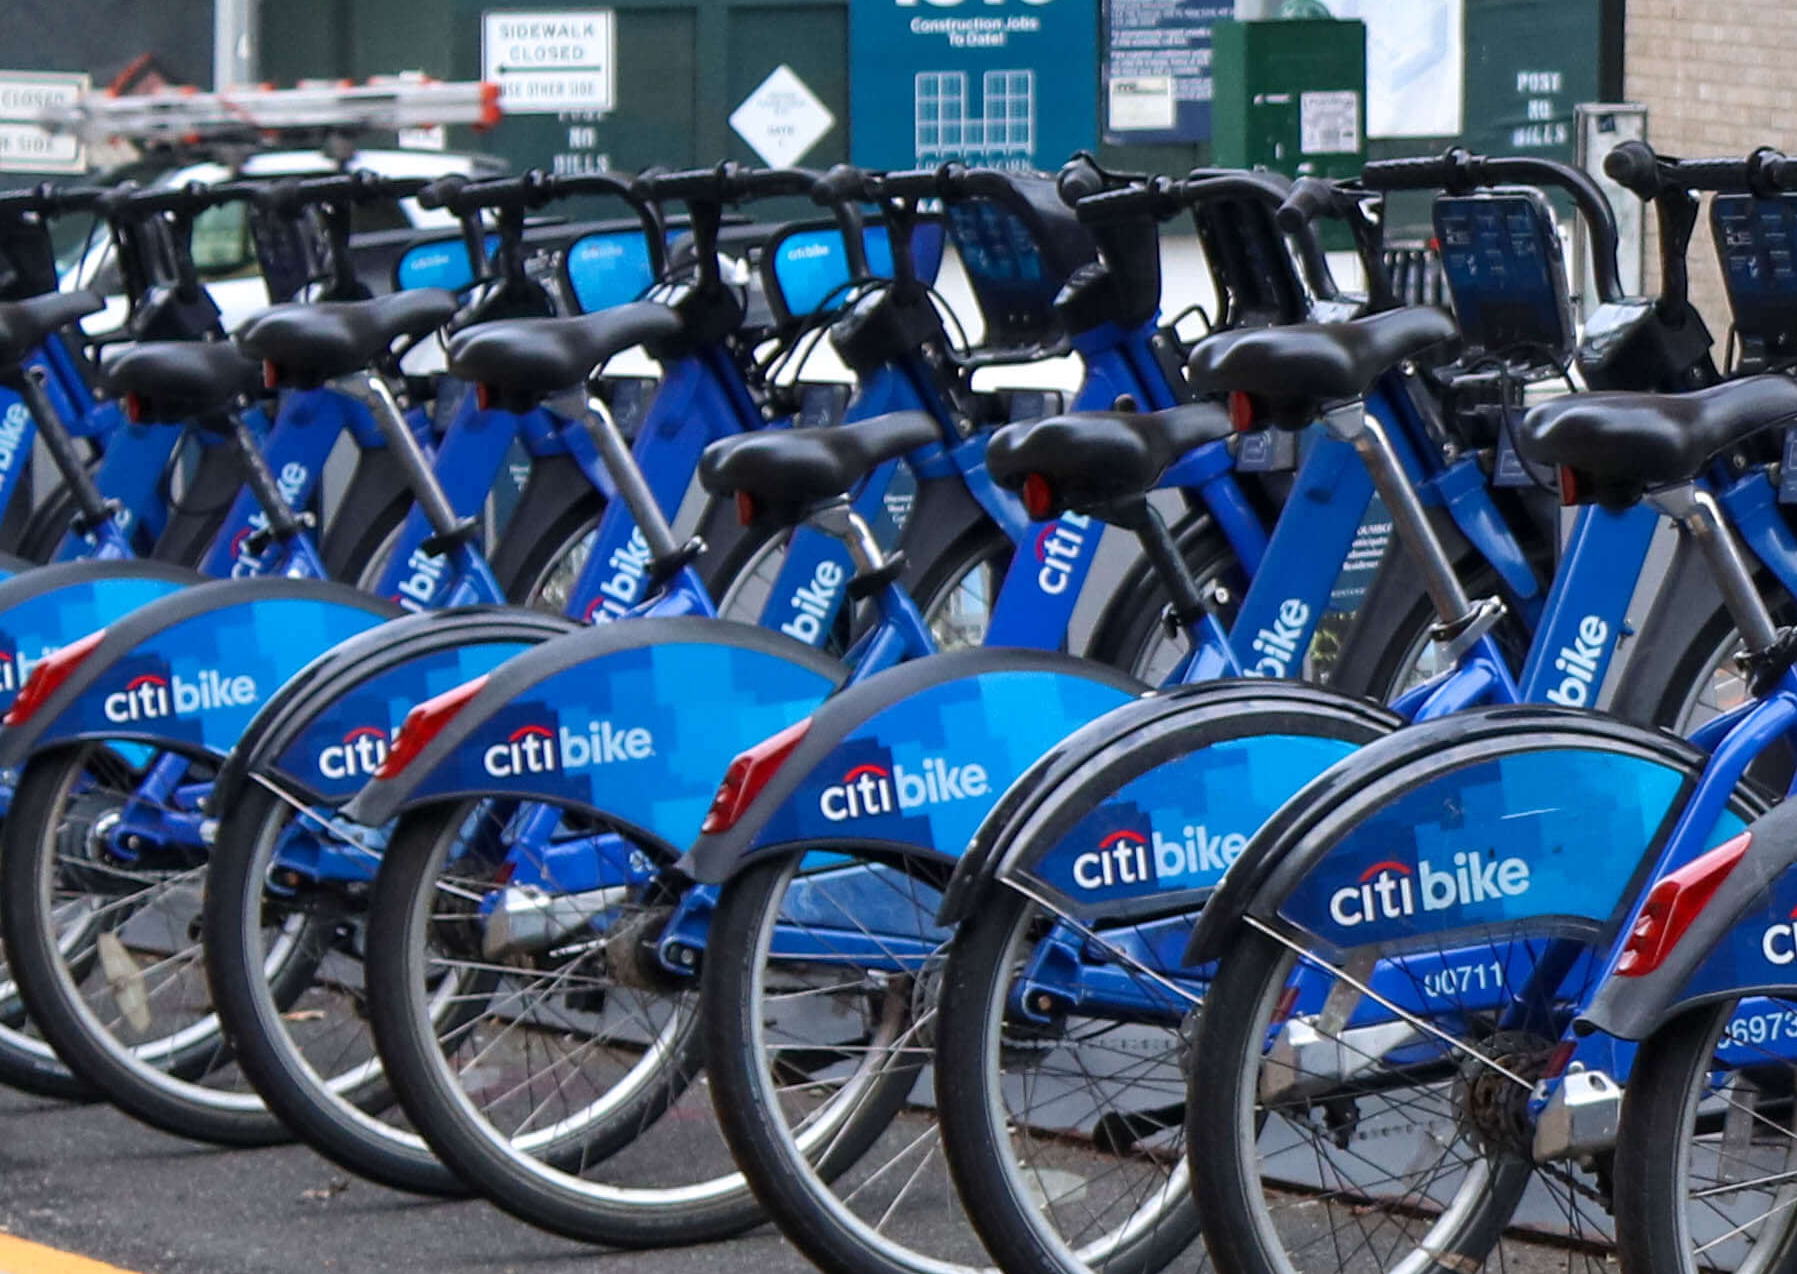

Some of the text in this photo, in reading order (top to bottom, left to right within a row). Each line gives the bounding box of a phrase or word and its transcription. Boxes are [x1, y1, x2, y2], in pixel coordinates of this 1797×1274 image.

[500, 23, 595, 38] SIDEWALK
[910, 15, 1040, 33] Construction Jobs
[948, 32, 965, 46] To
[510, 45, 585, 61] CLOSED
[527, 82, 564, 97] OTHER
[1517, 72, 1561, 93] POST
[1528, 99, 1551, 121] NO
[569, 127, 597, 149] NO
[1512, 124, 1568, 147] BILLS
[398, 549, 448, 603] bik
[780, 559, 843, 646] bike
[1243, 597, 1309, 678] bike
[1547, 613, 1609, 708] bike
[105, 673, 256, 723] citi bike
[484, 724, 653, 778] citi bike
[820, 757, 988, 822] citi bike
[1072, 825, 1249, 890] citi bike
[1329, 851, 1531, 928] citi bike
